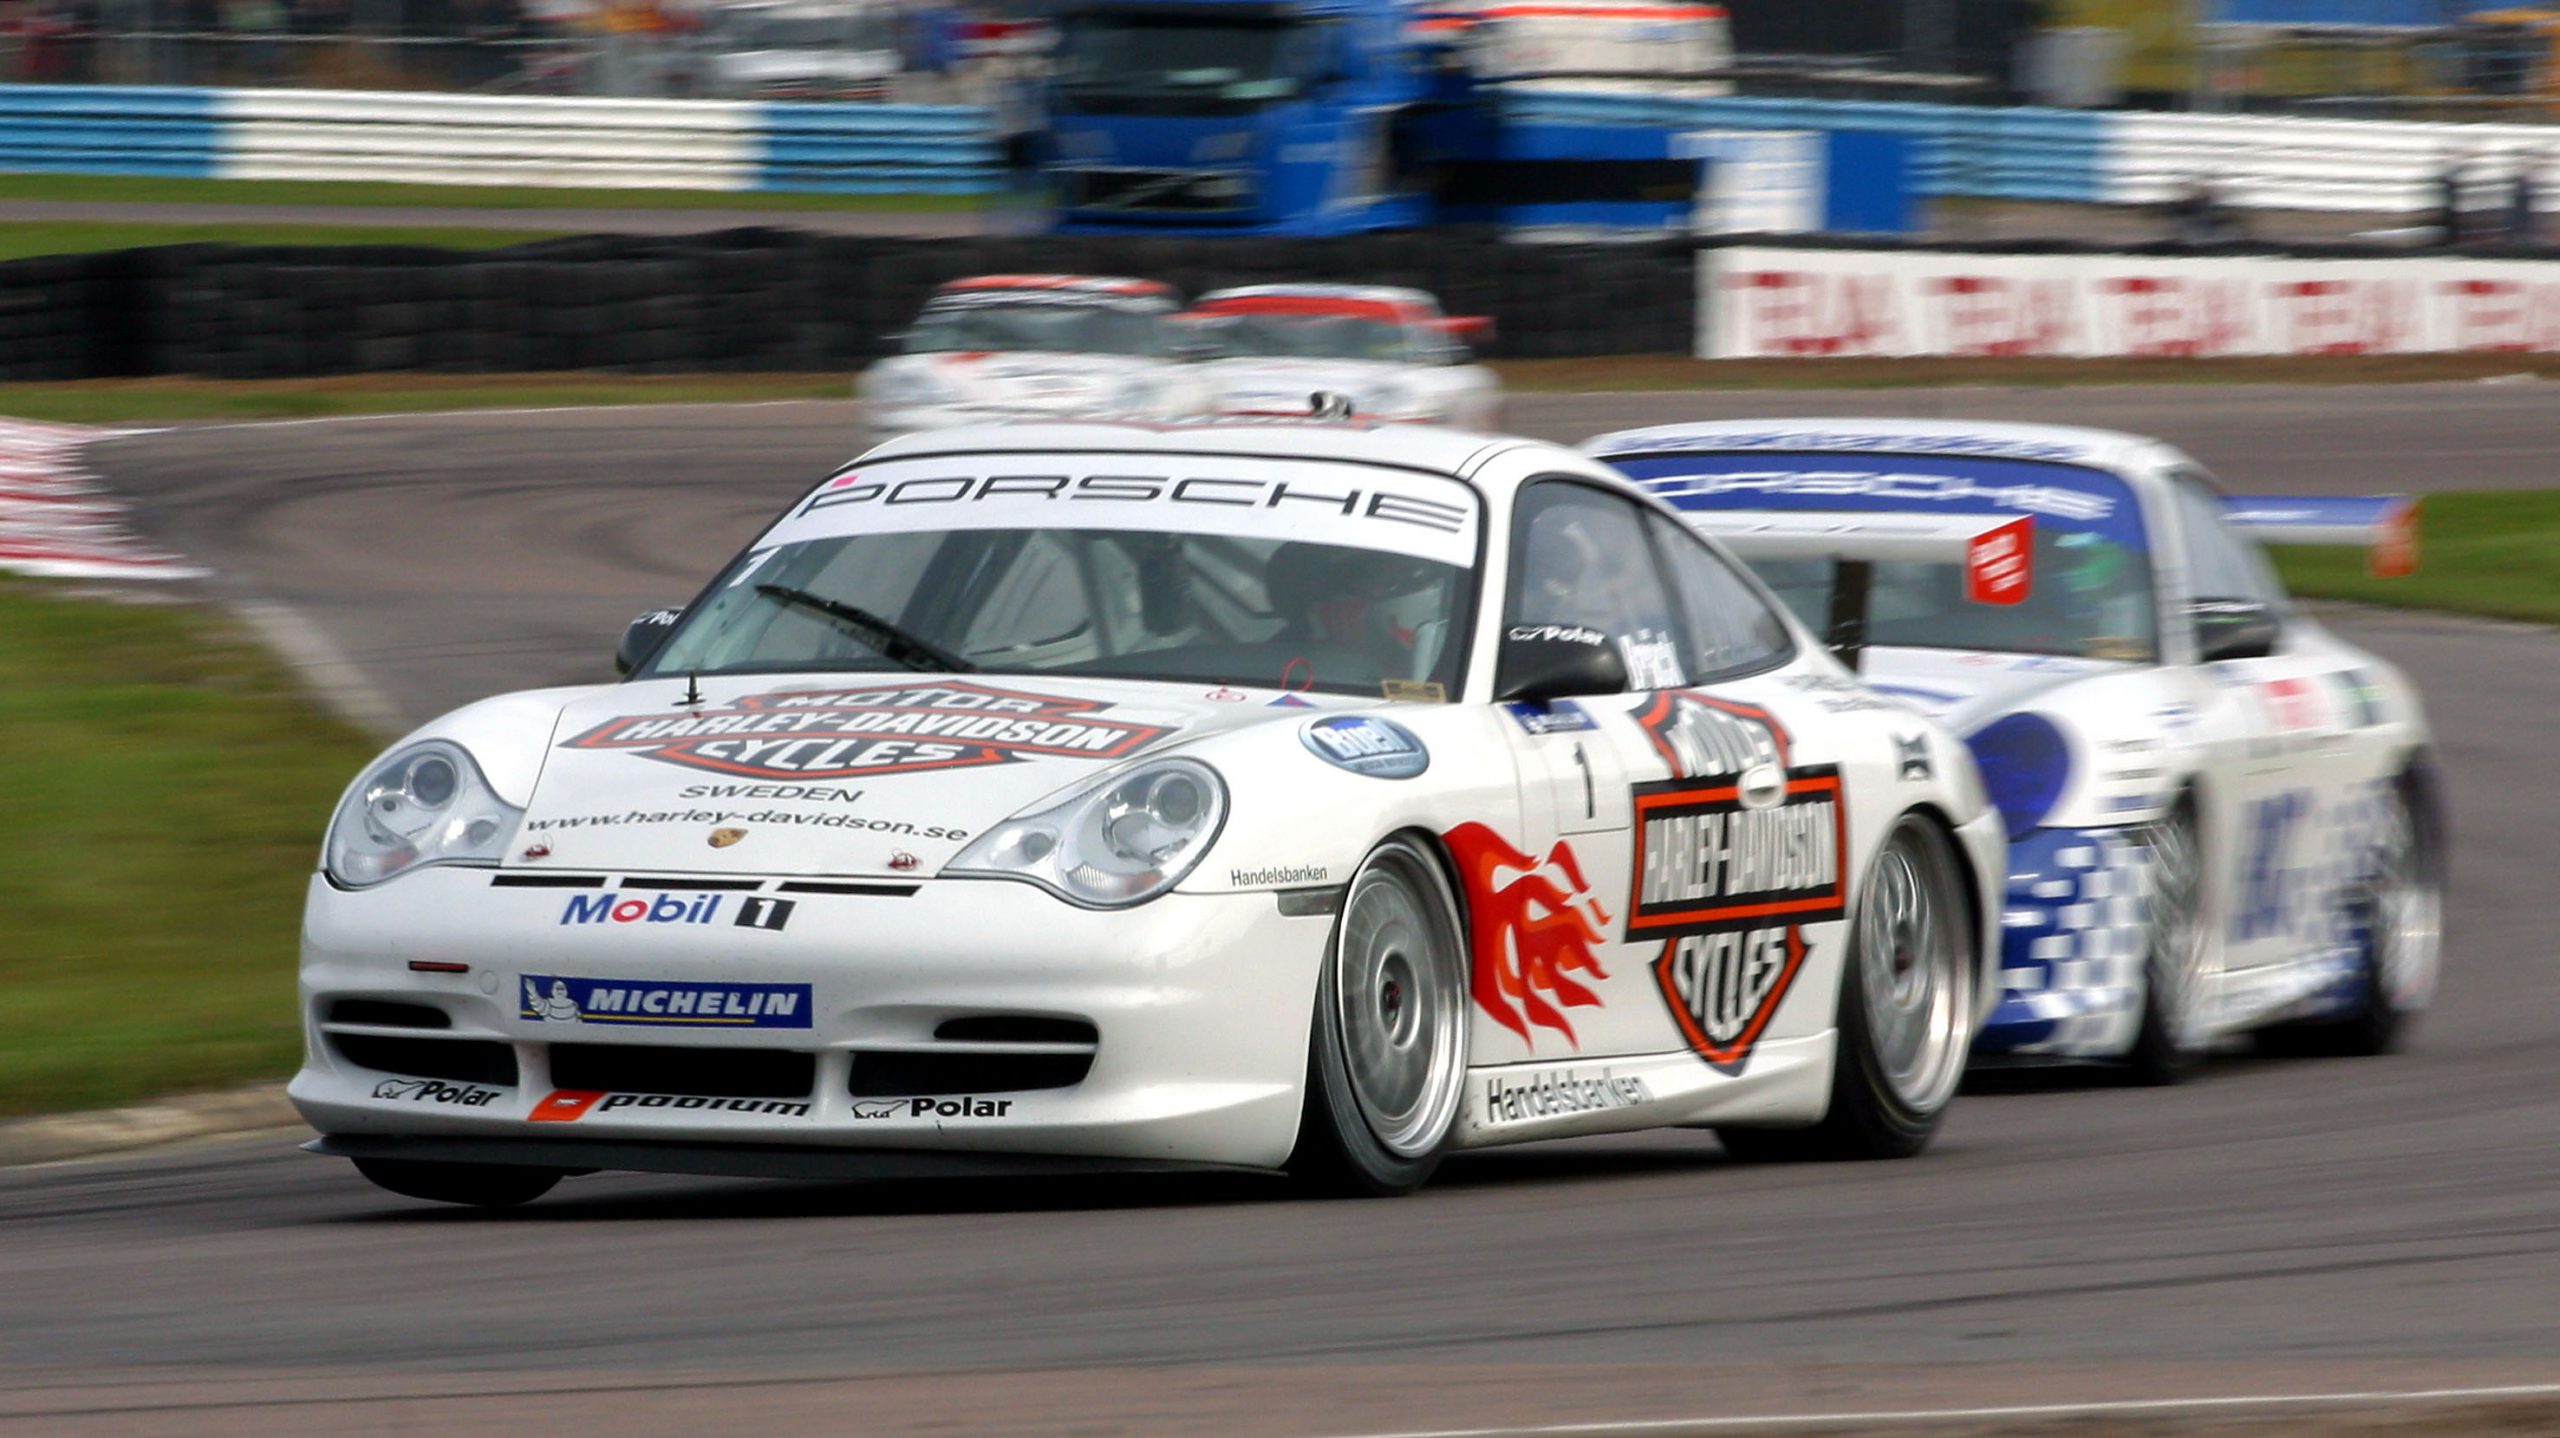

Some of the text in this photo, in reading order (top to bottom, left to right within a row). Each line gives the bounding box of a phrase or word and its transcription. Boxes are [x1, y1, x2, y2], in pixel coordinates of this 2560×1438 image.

[796, 474, 1469, 536] PORSCHE
[1638, 470, 2118, 520] ORSCHE
[728, 546, 783, 588] 1
[648, 609, 682, 626] Pol
[1543, 624, 1606, 646] Polar
[776, 687, 1044, 713] MOTOR
[613, 710, 1128, 750] HARLEY-DAVIDSON
[694, 739, 966, 771] CYCLES
[678, 784, 865, 803] SWEDEN
[1572, 741, 1596, 820] 1
[526, 808, 970, 843] www.harley-davidson.se
[1230, 864, 1329, 888] Handelsbanken
[560, 893, 722, 925] Mobil
[586, 988, 798, 1016] MICHELIN
[412, 1079, 503, 1107] Polar
[911, 1096, 1013, 1118] Polar
[1487, 1067, 1656, 1124] Handelsbanken
